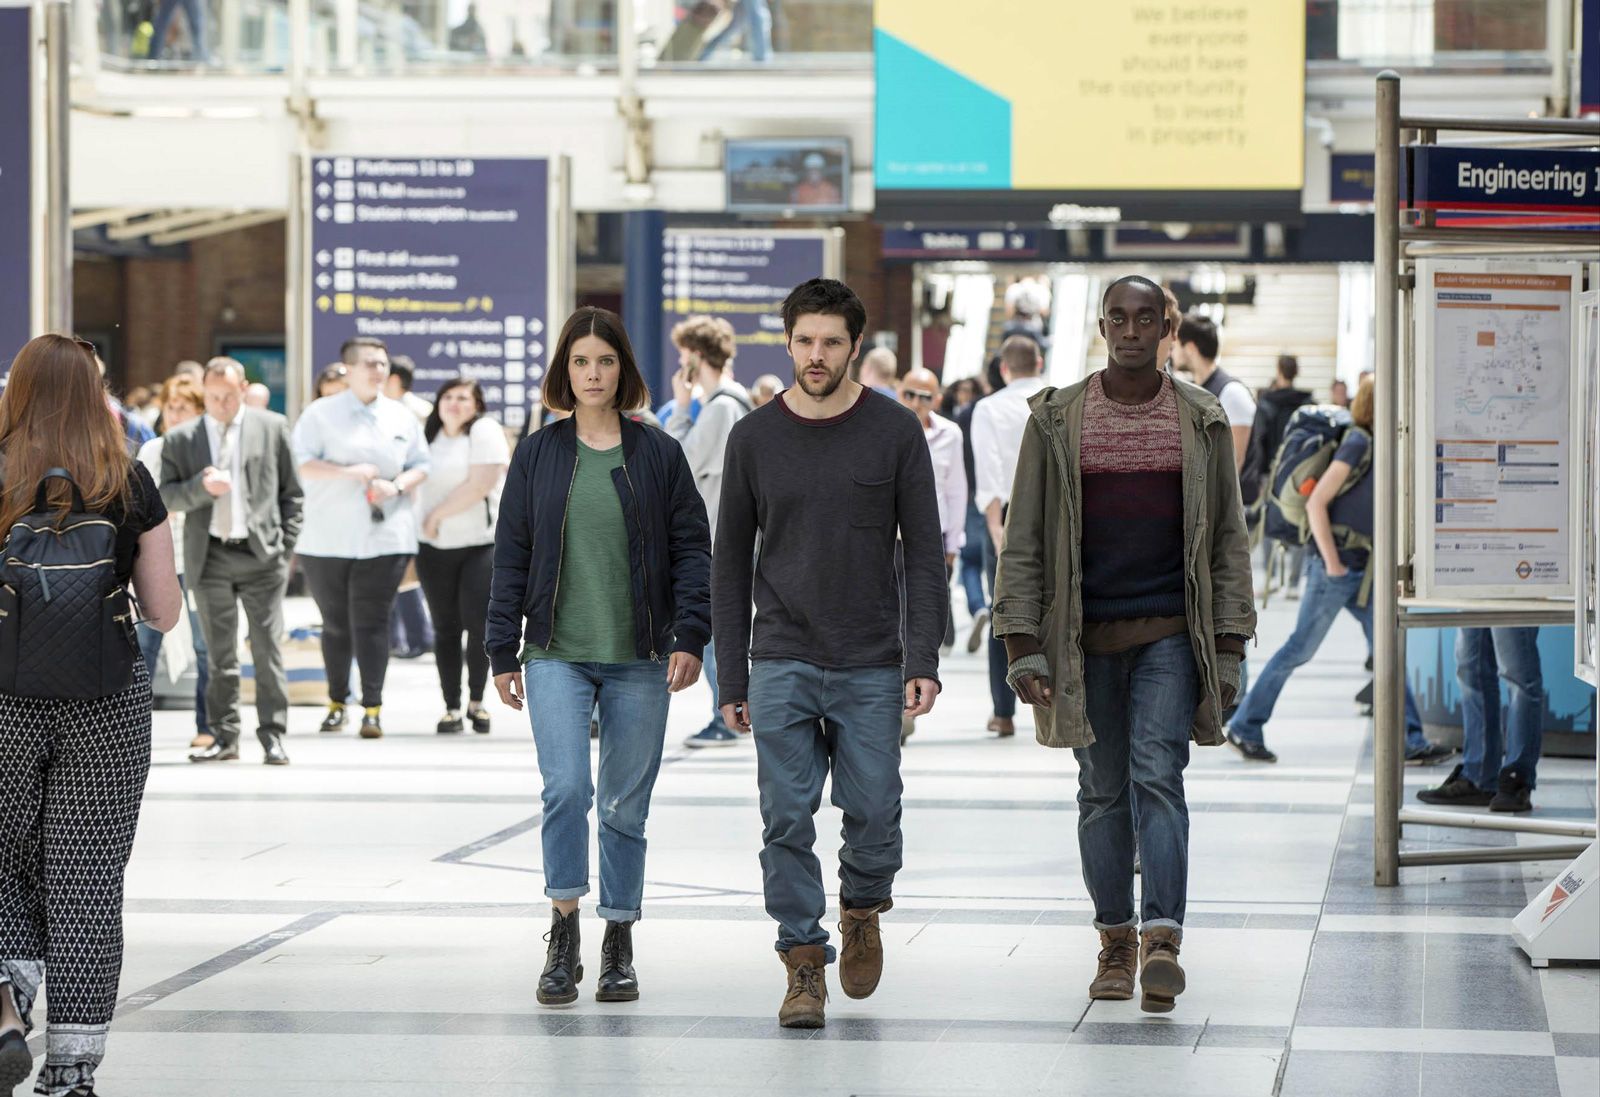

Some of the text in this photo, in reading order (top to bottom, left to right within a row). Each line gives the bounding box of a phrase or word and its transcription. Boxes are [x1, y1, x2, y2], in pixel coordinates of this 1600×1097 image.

[1134, 5, 1247, 21] We believe
[1149, 32, 1247, 47] everyone
[1123, 55, 1247, 71] should have
[1080, 79, 1247, 99] the opportunity
[1153, 102, 1244, 118] to invest
[1128, 126, 1246, 148] in property
[357, 159, 418, 177] Platforms
[1457, 162, 1586, 197] Engineering
[357, 204, 404, 221] Station
[405, 205, 467, 224] reception
[357, 249, 387, 267] First
[387, 249, 409, 267] aid
[357, 271, 457, 292] Transport Police
[356, 317, 503, 335] Tickets and information
